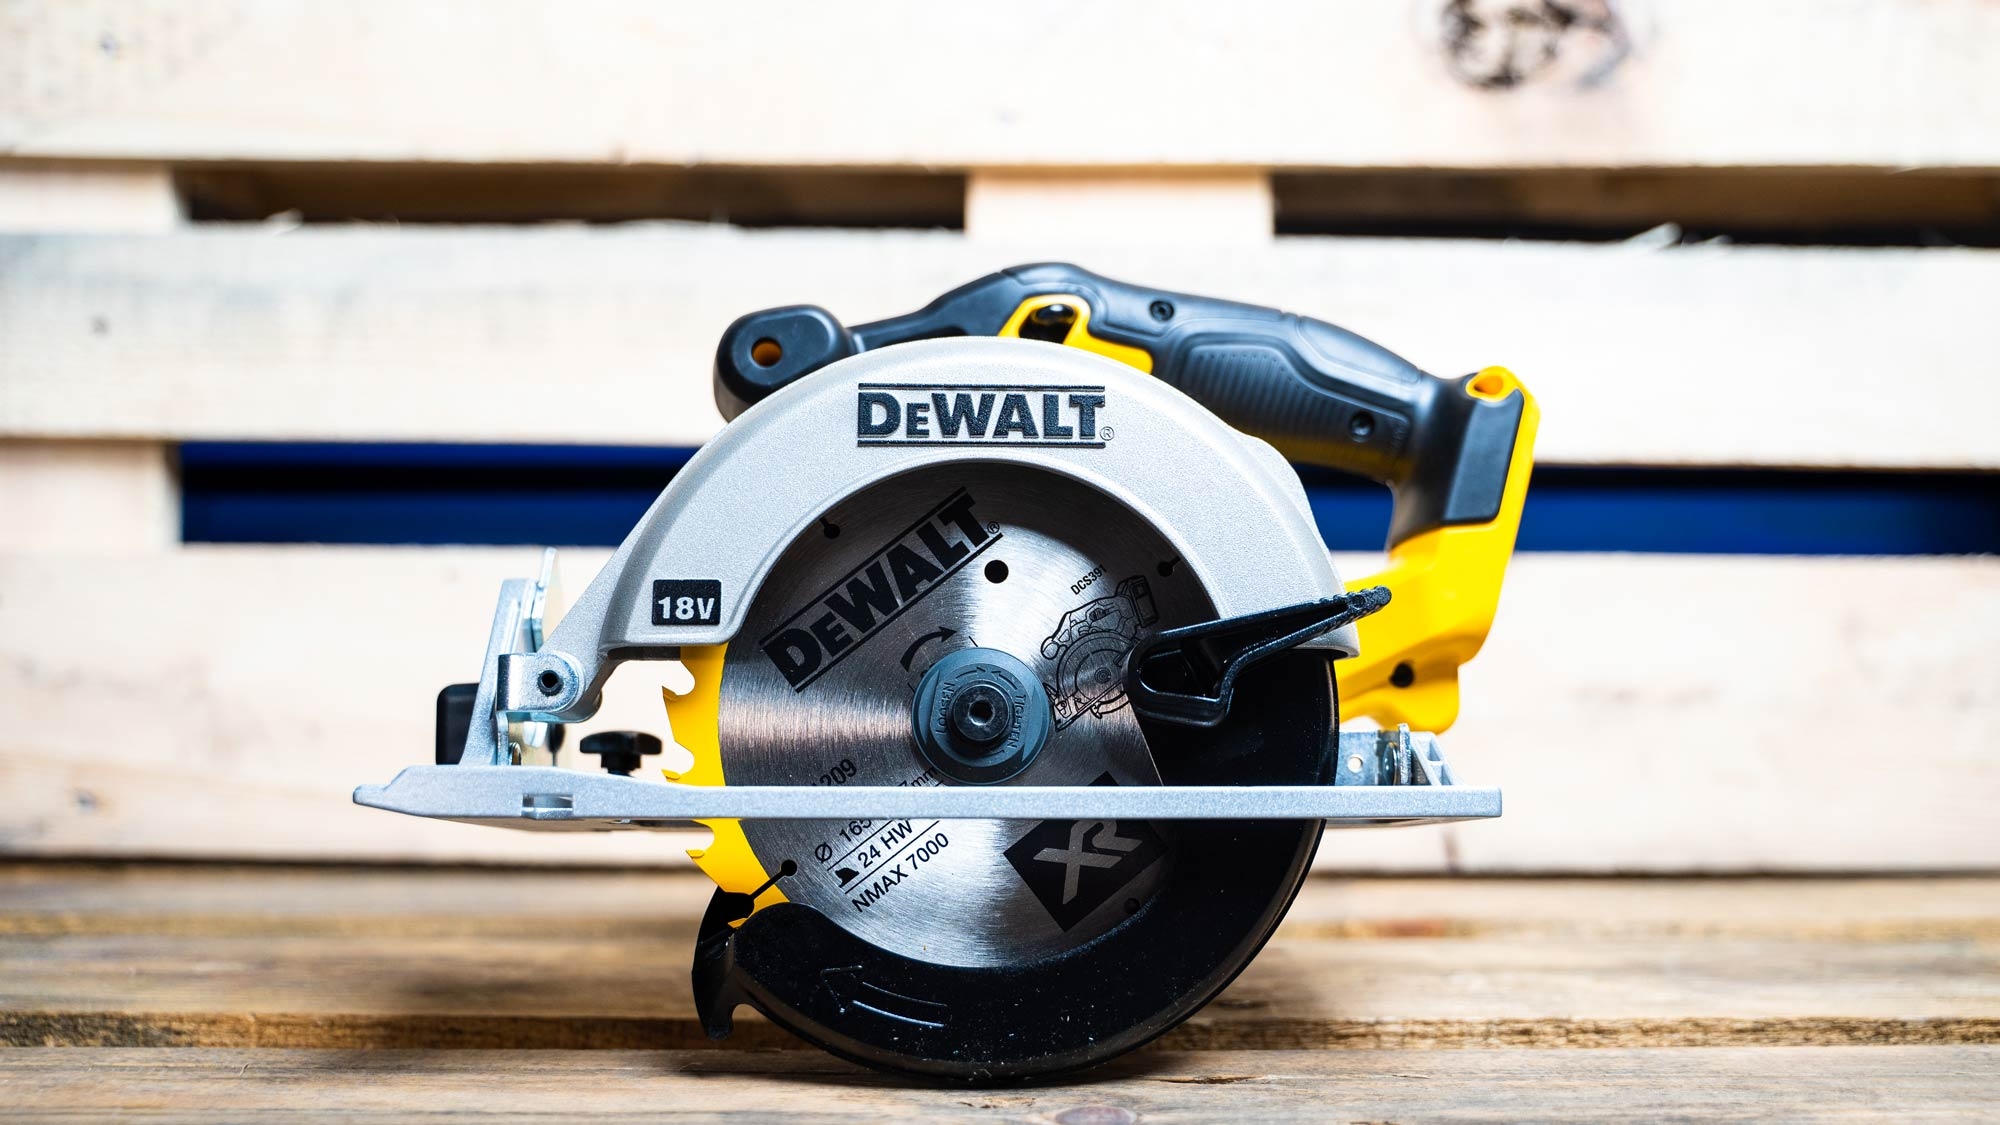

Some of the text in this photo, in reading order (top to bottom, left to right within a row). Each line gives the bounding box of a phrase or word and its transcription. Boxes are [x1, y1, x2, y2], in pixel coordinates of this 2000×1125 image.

[1071, 564, 1107, 595] DCS391
[658, 596, 715, 620] 18V
[935, 682, 956, 735] LOOSEN
[1006, 694, 1026, 748] TIGHTEN
[811, 759, 857, 786] 209
[858, 819, 913, 868] 24 HW
[851, 832, 949, 913] NMAX 7000
